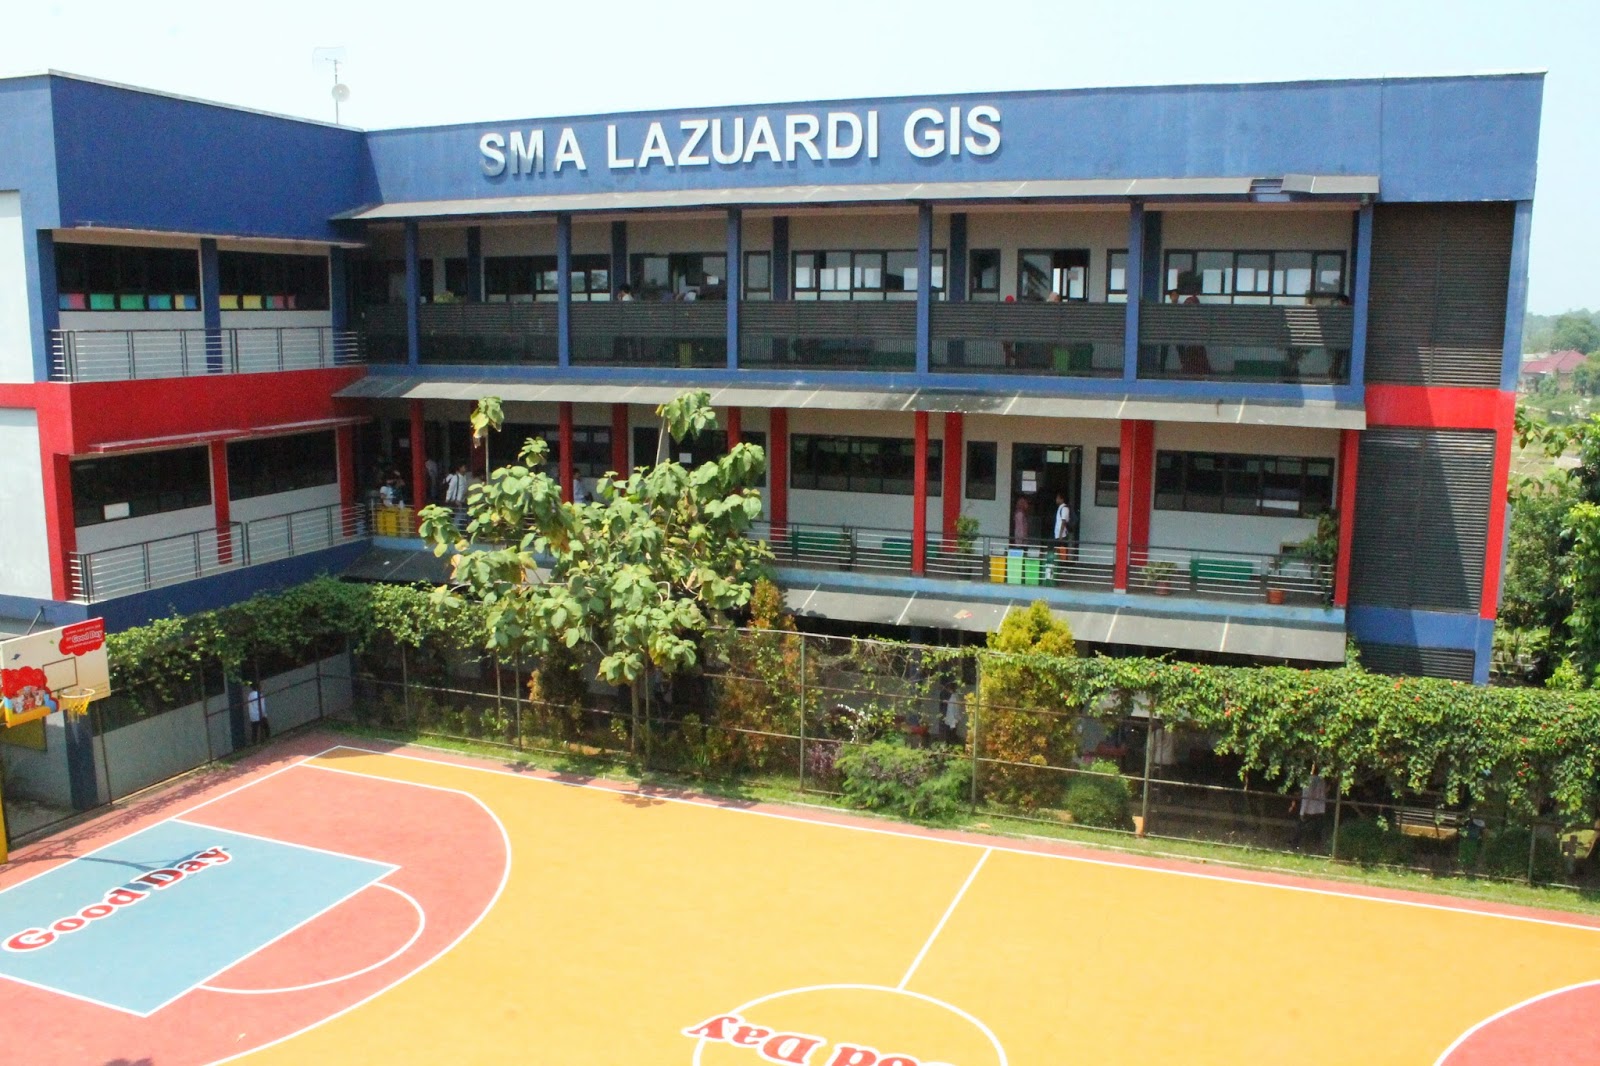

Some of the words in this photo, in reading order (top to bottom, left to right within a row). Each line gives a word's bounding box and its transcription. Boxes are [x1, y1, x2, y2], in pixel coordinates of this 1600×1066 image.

[478, 128, 587, 176] SMA
[606, 110, 880, 170] LAZUARDI
[903, 105, 1001, 159] GIS
[4, 887, 150, 952] Good
[129, 846, 232, 890] Day
[683, 1014, 824, 1065] Day
